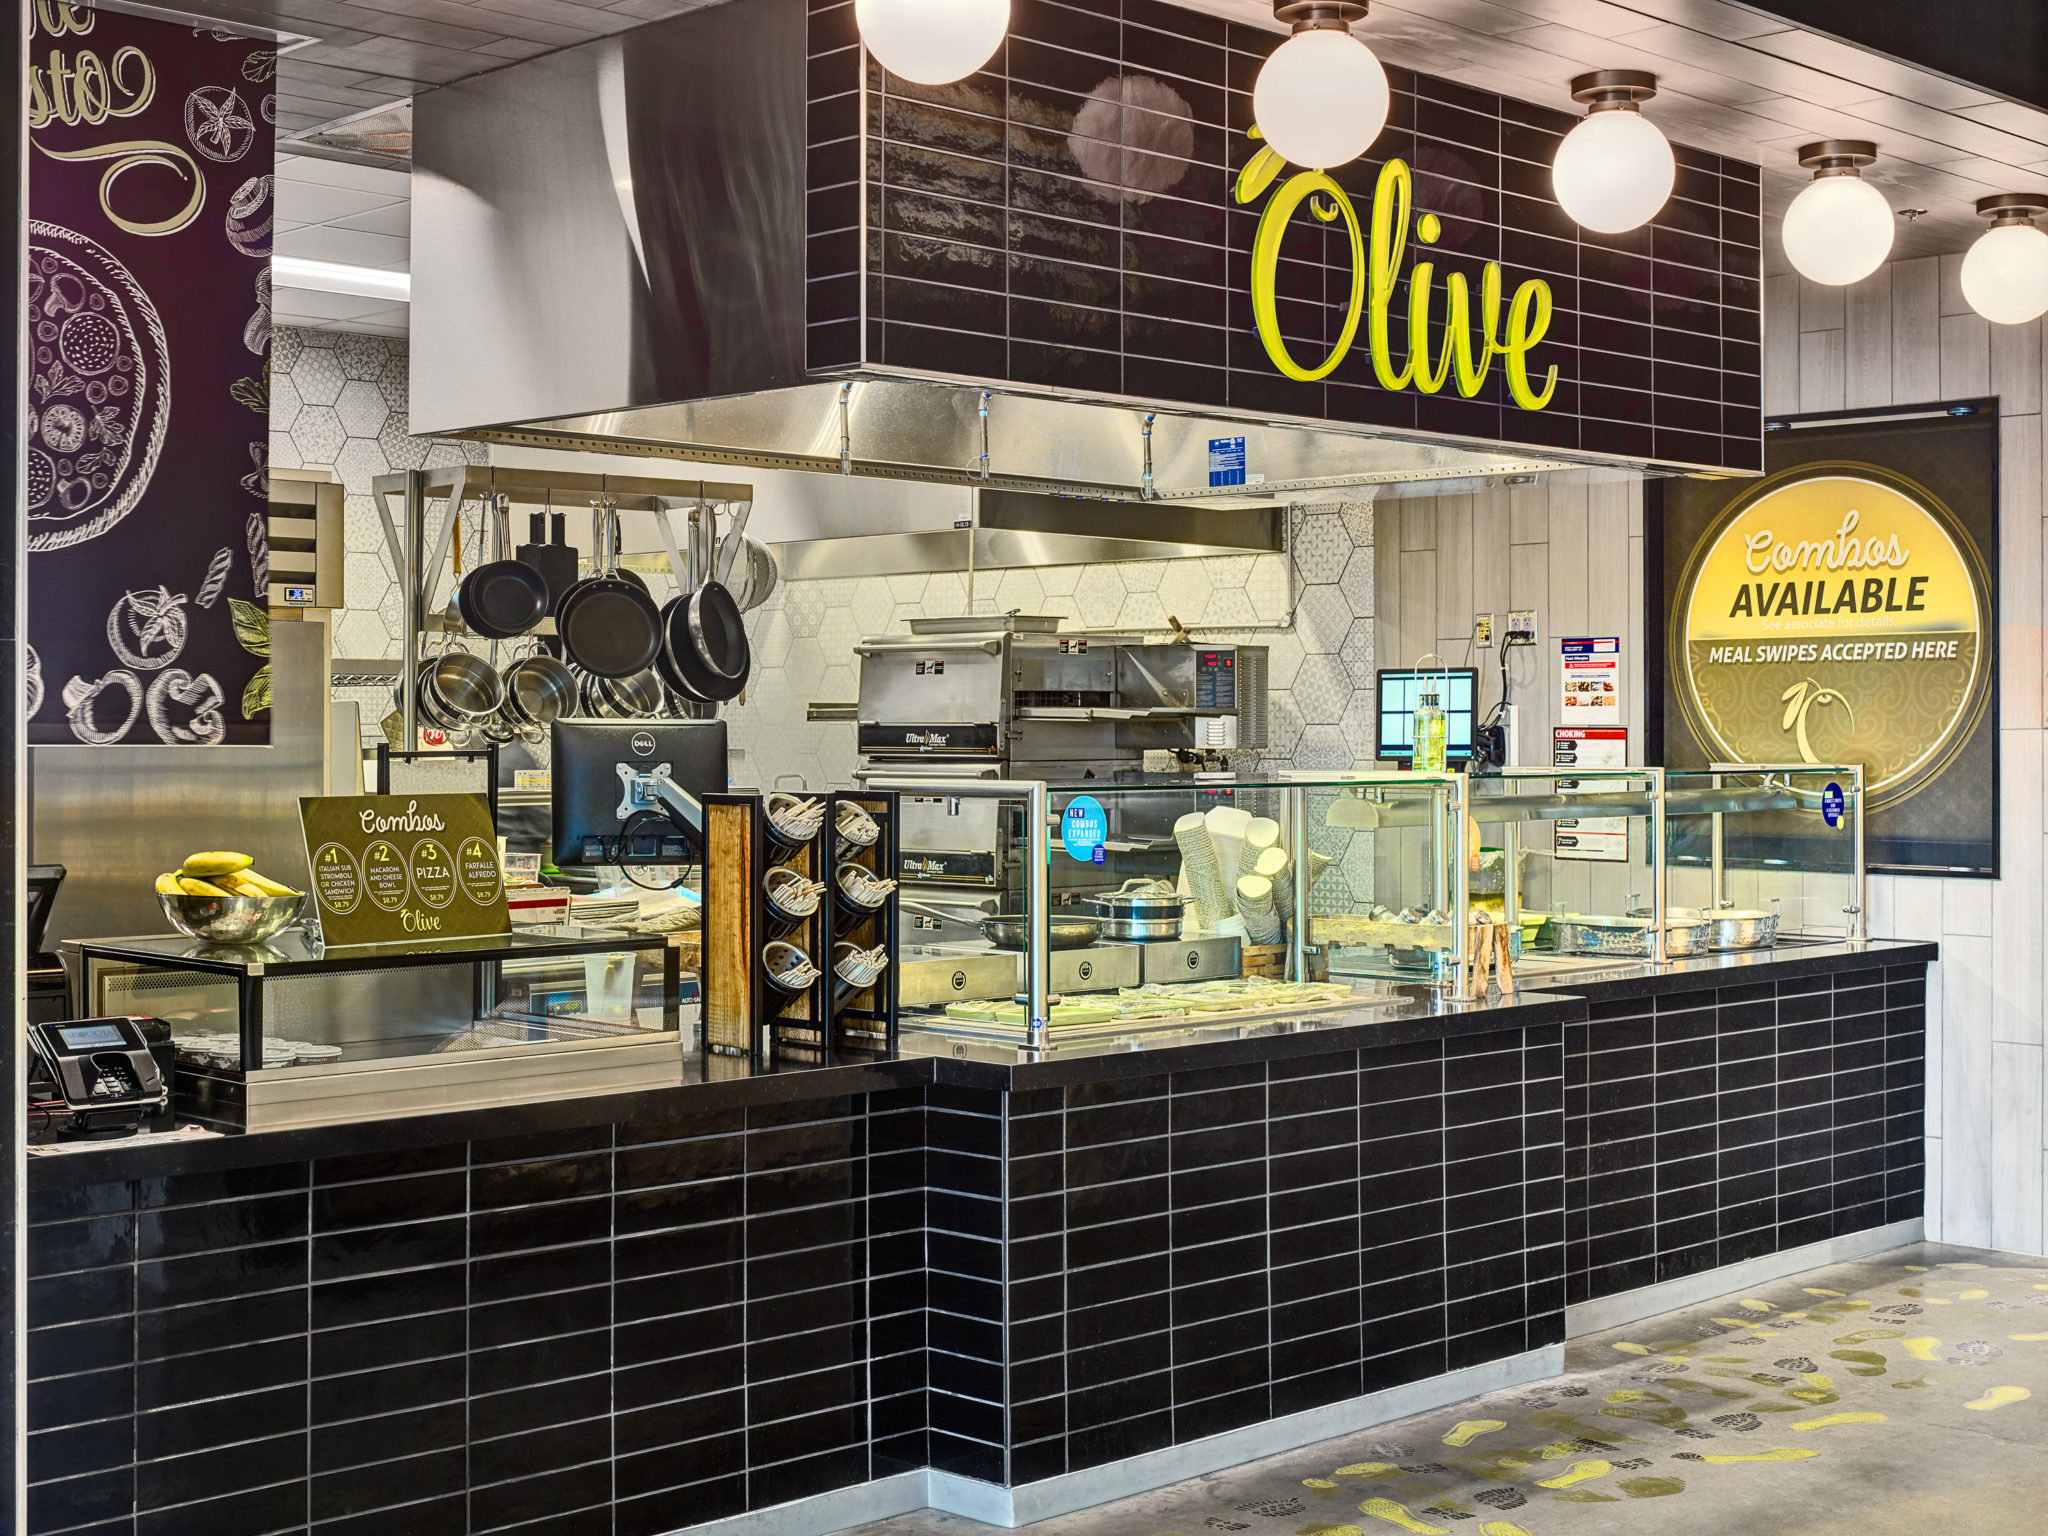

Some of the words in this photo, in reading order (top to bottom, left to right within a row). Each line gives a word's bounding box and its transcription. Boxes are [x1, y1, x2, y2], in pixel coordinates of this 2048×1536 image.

[1235, 143, 1558, 411] Olive
[1745, 509, 1910, 573] Combos
[1729, 576, 1929, 618] AVAILABLE
[1762, 618, 1782, 631] See
[1784, 617, 1836, 631] associate
[1838, 616, 1855, 629] for
[1856, 614, 1897, 629] details.
[1709, 646, 1752, 664] MEAL
[1755, 644, 1818, 663] SWIPES
[1820, 642, 1908, 662] ACCEPTED
[1911, 640, 1959, 660] HERE
[905, 733, 925, 744] Ultra
[1555, 729, 1586, 738] CHOKING
[359, 800, 446, 834] Combos
[1069, 808, 1084, 818] NEW
[324, 847, 338, 864] #1
[374, 845, 390, 862] #2
[421, 844, 437, 860] #3
[466, 842, 482, 858] #4
[416, 866, 450, 879] PIZZA
[465, 861, 494, 870] FARFALLE
[903, 859, 923, 870] Ultra
[468, 870, 497, 879] ALFREDO
[400, 908, 442, 933] Olive
